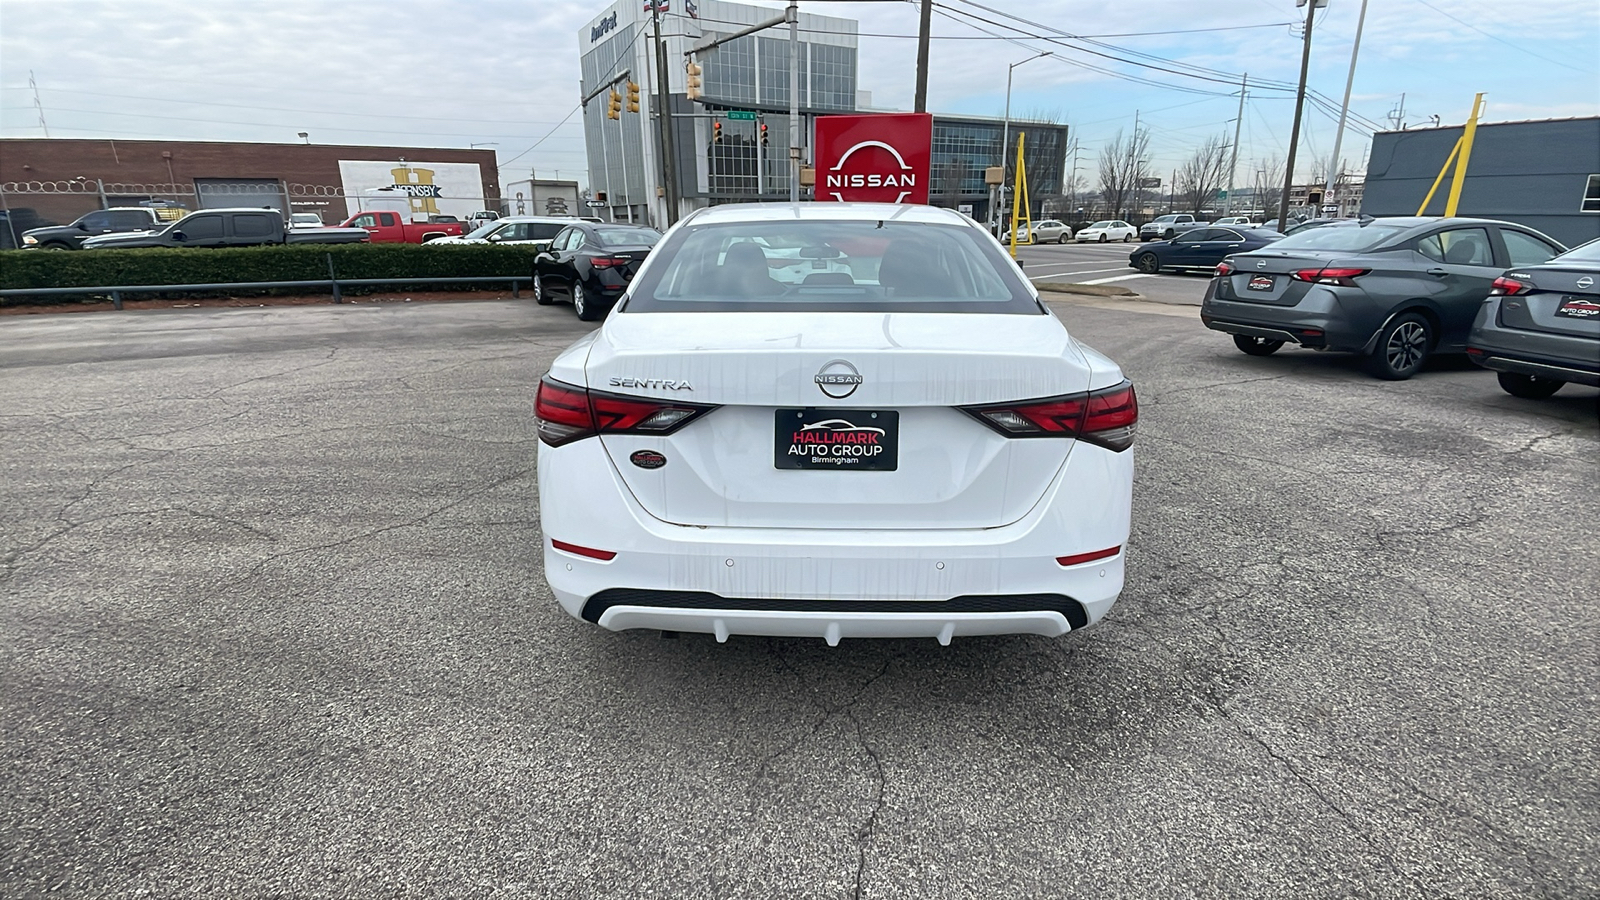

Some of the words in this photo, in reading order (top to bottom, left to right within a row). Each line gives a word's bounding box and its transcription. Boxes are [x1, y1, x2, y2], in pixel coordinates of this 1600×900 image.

[827, 174, 916, 187] NISSAN
[609, 376, 694, 391] SENTRA
[793, 432, 879, 444] HALLMARK
[787, 444, 828, 455] AUTO
[831, 445, 883, 456] GROUP
[811, 457, 859, 465] Birmingham
